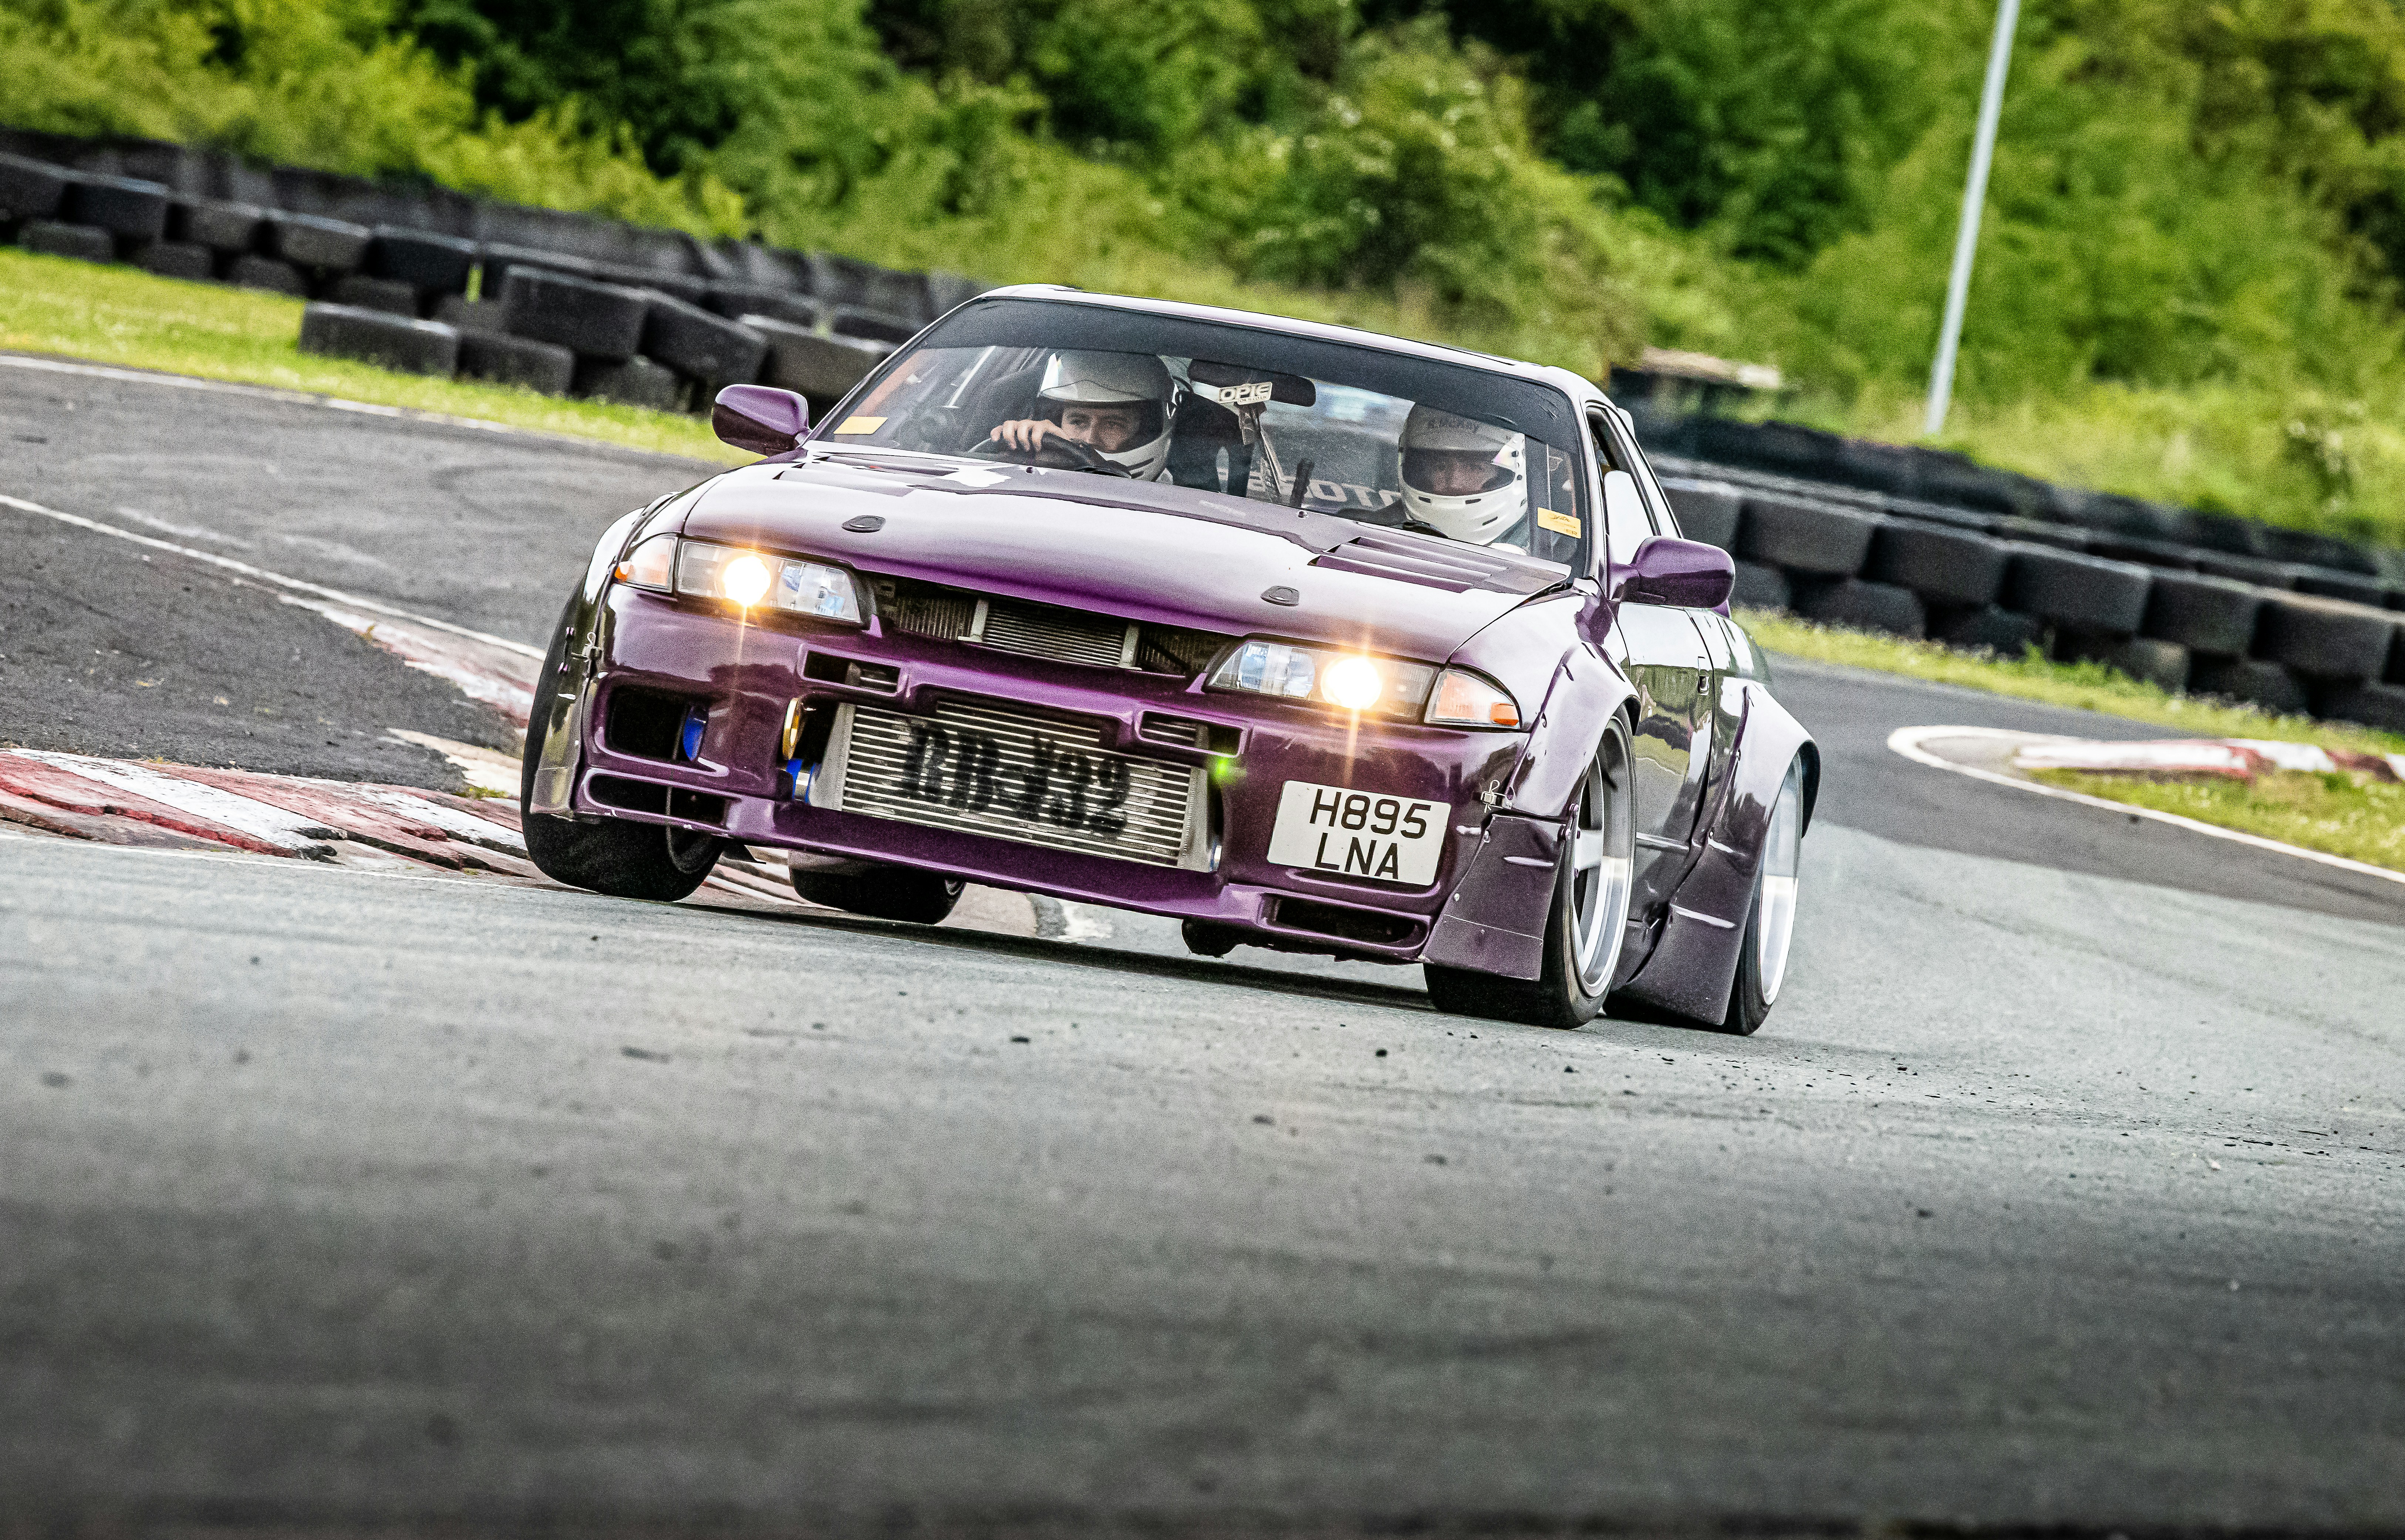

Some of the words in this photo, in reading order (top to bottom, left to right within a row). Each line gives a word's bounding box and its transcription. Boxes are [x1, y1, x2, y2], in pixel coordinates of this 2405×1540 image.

[1221, 385, 1269, 401] OPIE
[1309, 789, 1431, 839] H895
[1315, 833, 1399, 879] LNA
